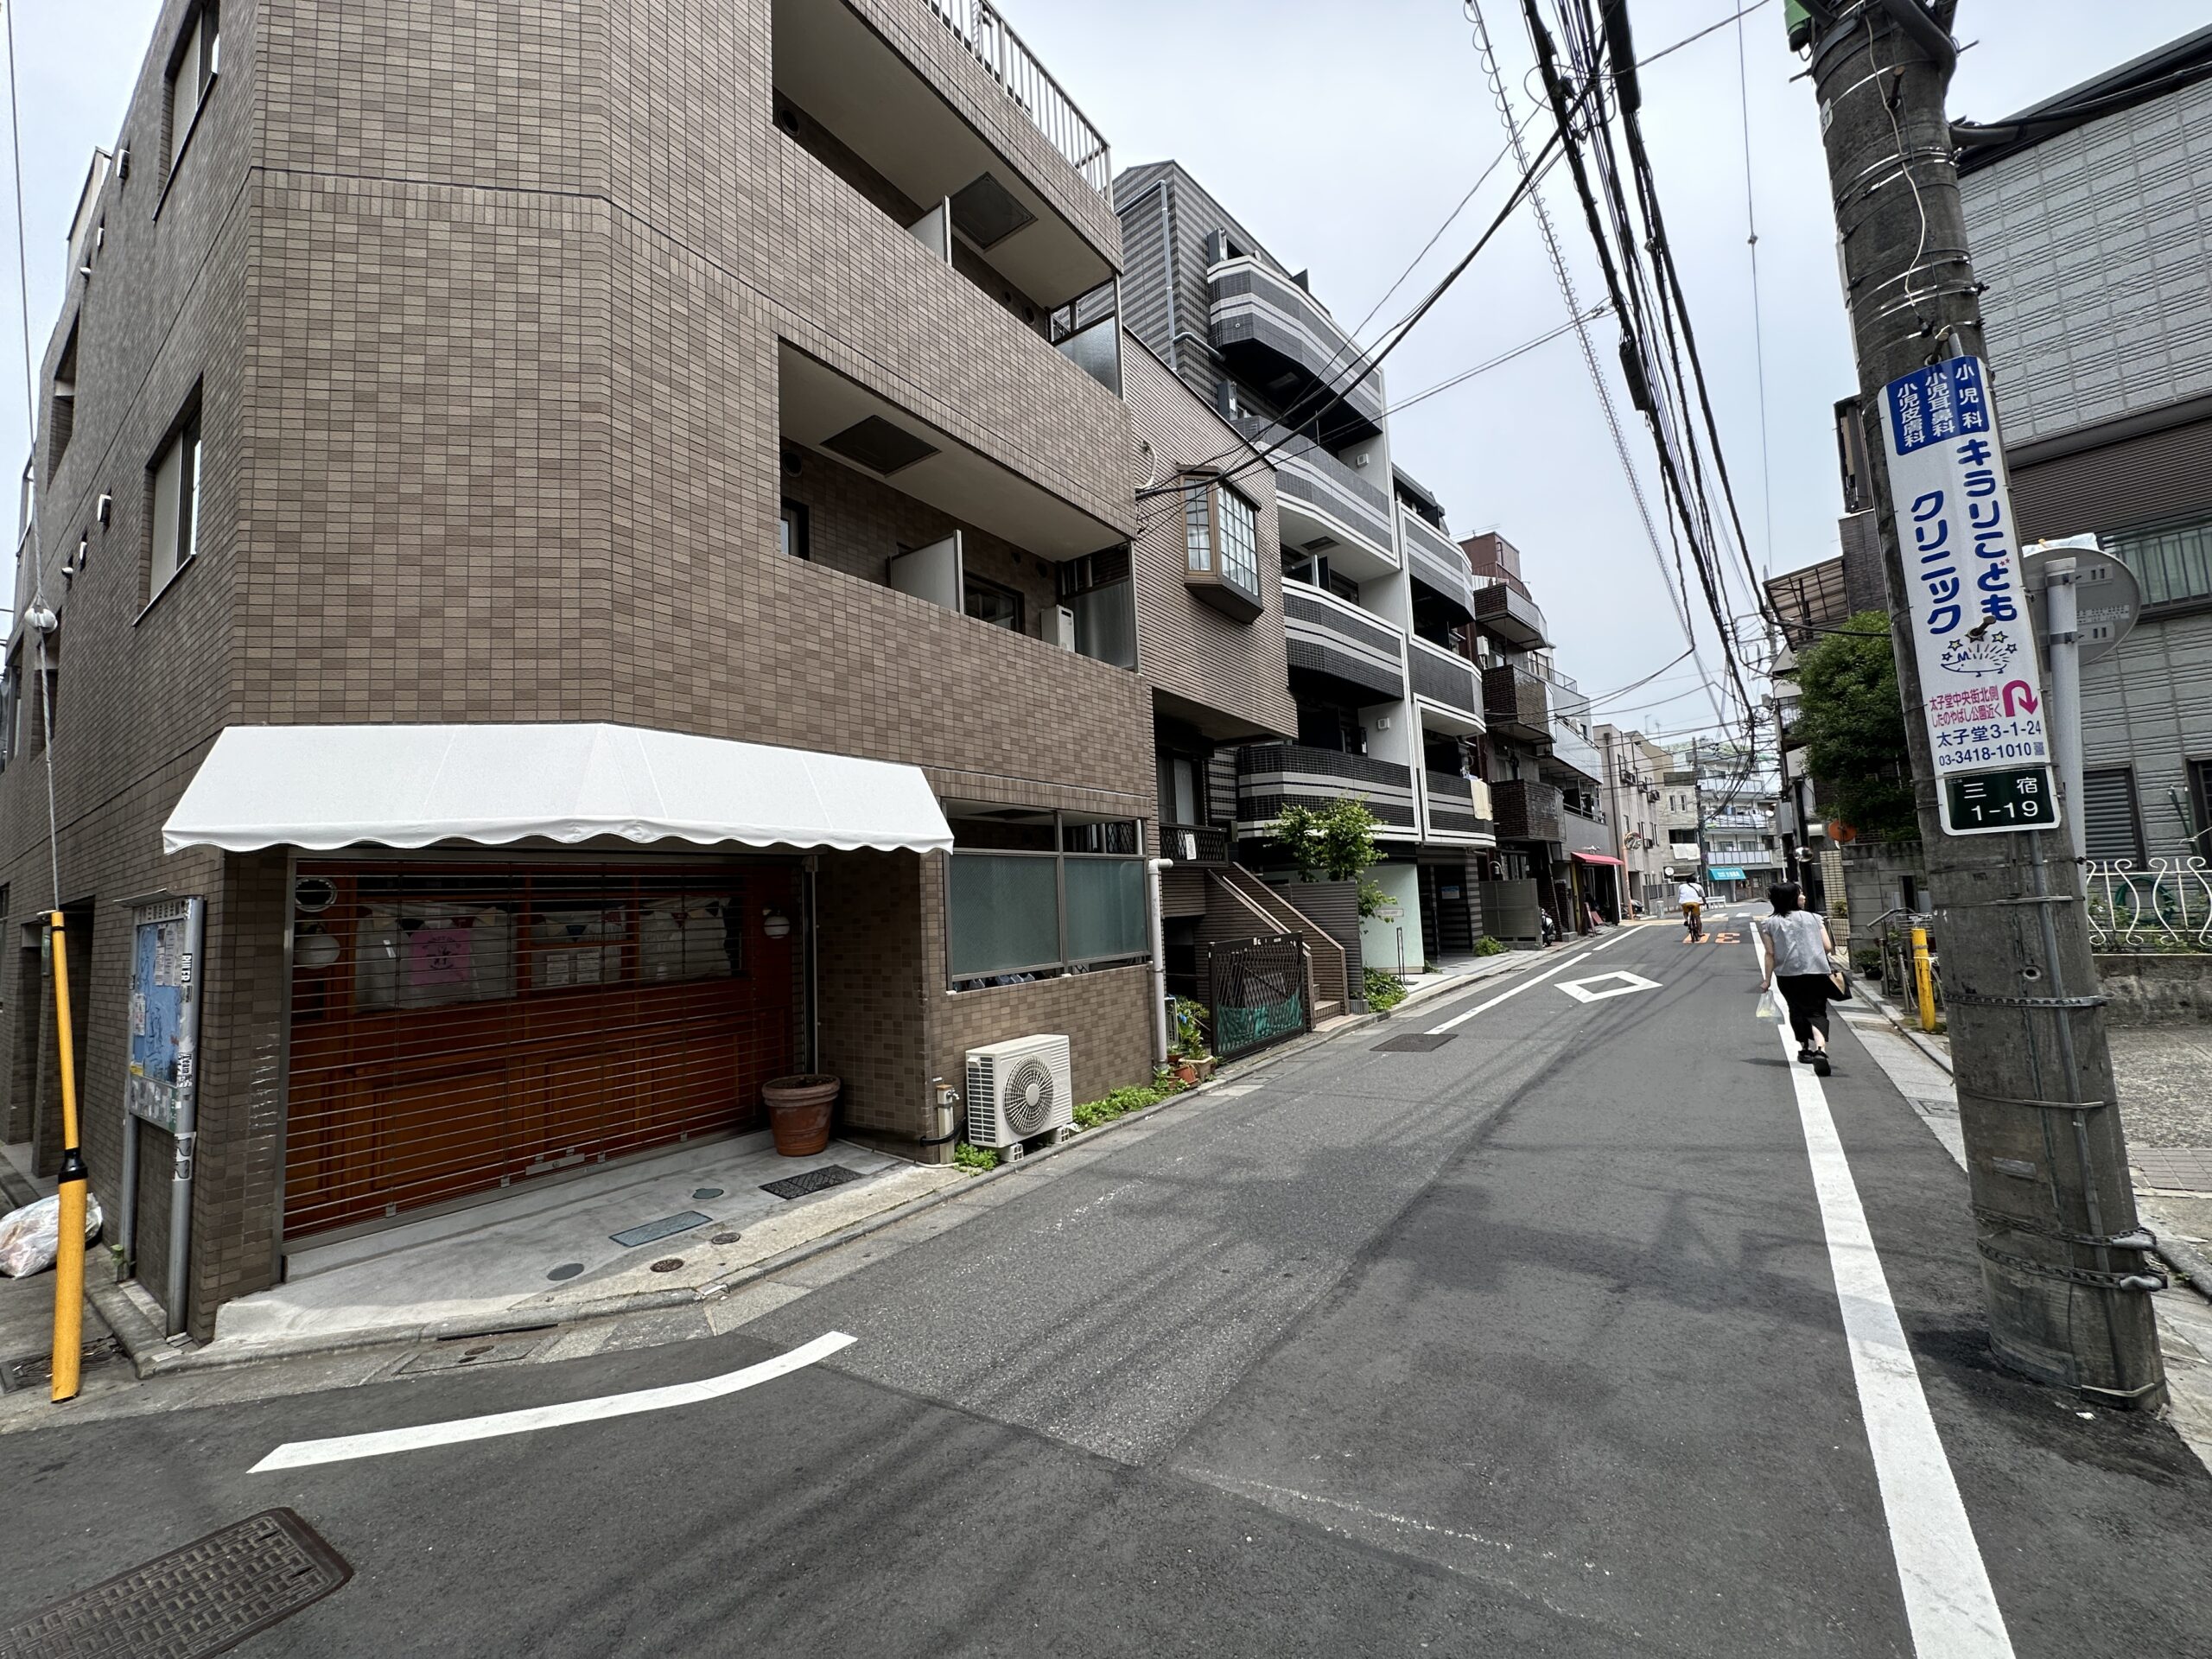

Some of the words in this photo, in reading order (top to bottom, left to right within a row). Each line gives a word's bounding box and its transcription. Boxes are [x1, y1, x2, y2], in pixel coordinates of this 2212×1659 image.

[1897, 383, 1926, 448] 小児皮膚科
[1925, 372, 1955, 437] 小児耳鼻科
[1955, 364, 1983, 429] 小児科
[1910, 490, 1961, 634] クリニック
[1956, 439, 2018, 621] キラリこども
[1929, 685, 1999, 712] 太子堂中央街北側
[1938, 742, 2031, 766] 03-3418-1010
[1971, 800, 2038, 821] 1-19
